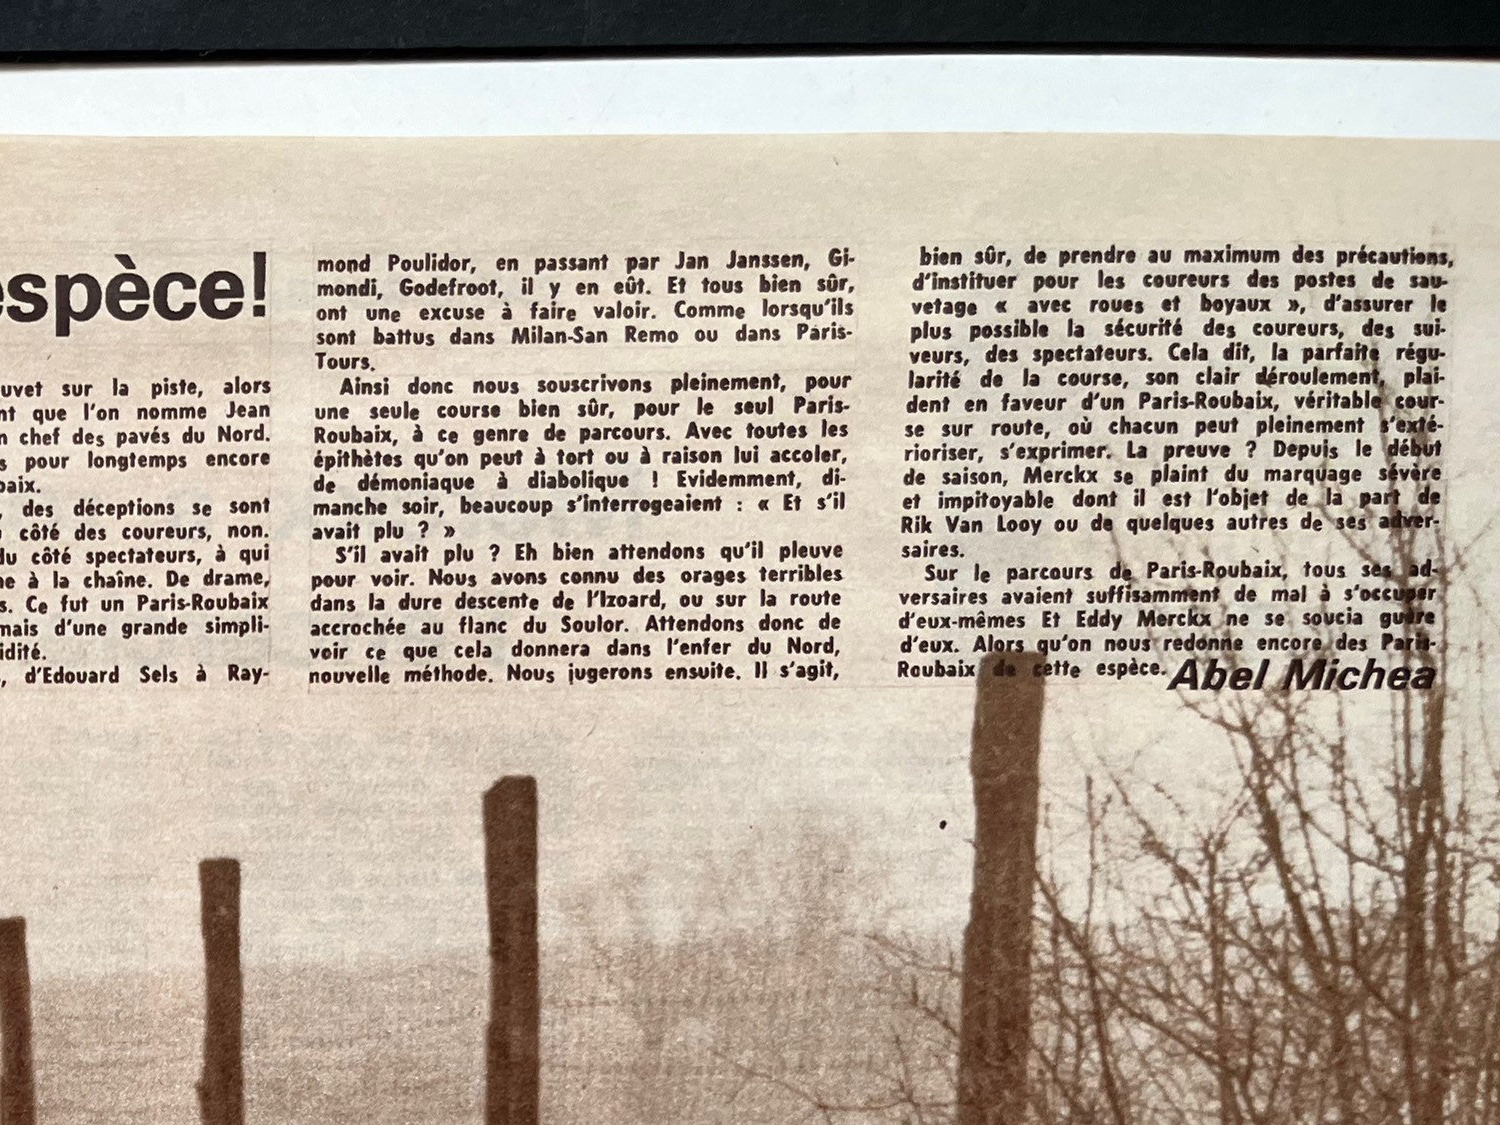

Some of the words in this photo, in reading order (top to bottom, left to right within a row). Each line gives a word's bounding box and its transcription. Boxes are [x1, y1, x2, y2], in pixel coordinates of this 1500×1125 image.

[912, 271, 1017, 291] d'instituer
[1033, 275, 1079, 293] pour
[1098, 269, 1125, 290] les
[1143, 273, 1230, 288] coureurs
[1247, 268, 1279, 289] des
[1294, 271, 1356, 292] postes
[1372, 270, 1395, 290] de
[1410, 275, 1448, 289] sau-
[316, 329, 356, 346] sont
[373, 326, 435, 347] battus
[449, 326, 495, 345] dans
[511, 325, 608, 345] Milan-San
[625, 325, 679, 343] Remo
[694, 329, 718, 343] ou
[735, 323, 781, 342] dans
[797, 321, 853, 341] Paris-
[62, 383, 93, 397] sur
[112, 377, 129, 396] la
[151, 377, 203, 400] piste,
[223, 375, 271, 395] alors
[339, 376, 389, 396] Ainsi
[407, 376, 454, 395] donc
[473, 380, 520, 395] nous
[537, 373, 652, 394] souscrivons
[670, 372, 786, 395] pleinement,
[805, 375, 852, 393] pour
[906, 394, 950, 414] dent
[964, 398, 988, 413] en
[1001, 392, 1067, 412] faveur
[1081, 391, 1125, 411] d'un
[1139, 390, 1279, 412] Paris-Roubaix,
[1294, 389, 1384, 409] véritable
[19, 427, 60, 446] chef
[72, 427, 105, 447] des
[116, 425, 170, 448] pavés
[182, 425, 205, 444] du
[217, 423, 270, 443] Nord.
[903, 468, 926, 486] de
[942, 466, 1008, 487] saison,
[1023, 464, 1098, 484] Merckx
[1113, 470, 1134, 485] se
[1151, 463, 1209, 487] plaint
[1224, 463, 1249, 482] du
[1264, 468, 1362, 486] marquage
[1379, 462, 1442, 482] sévère
[22, 498, 54, 518] des
[73, 497, 175, 520] déceptions
[192, 502, 212, 517] se
[229, 497, 270, 514] sont
[311, 574, 356, 592] pour
[370, 568, 415, 587] voir.
[428, 568, 477, 588] Nous
[491, 572, 547, 586] avons
[560, 571, 620, 585] connu
[633, 565, 666, 584] des
[680, 570, 747, 587] orages
[759, 563, 843, 582] terribles
[24, 665, 120, 684] d'Edouard
[139, 664, 178, 684] Sels
[196, 663, 207, 682] à
[227, 663, 269, 685] Ray-
[897, 659, 976, 679] Roubaix
[1032, 660, 1081, 679] cette
[1096, 656, 1168, 680] espèce.
[1167, 660, 1268, 692] Abel
[1284, 658, 1438, 692] Michea
